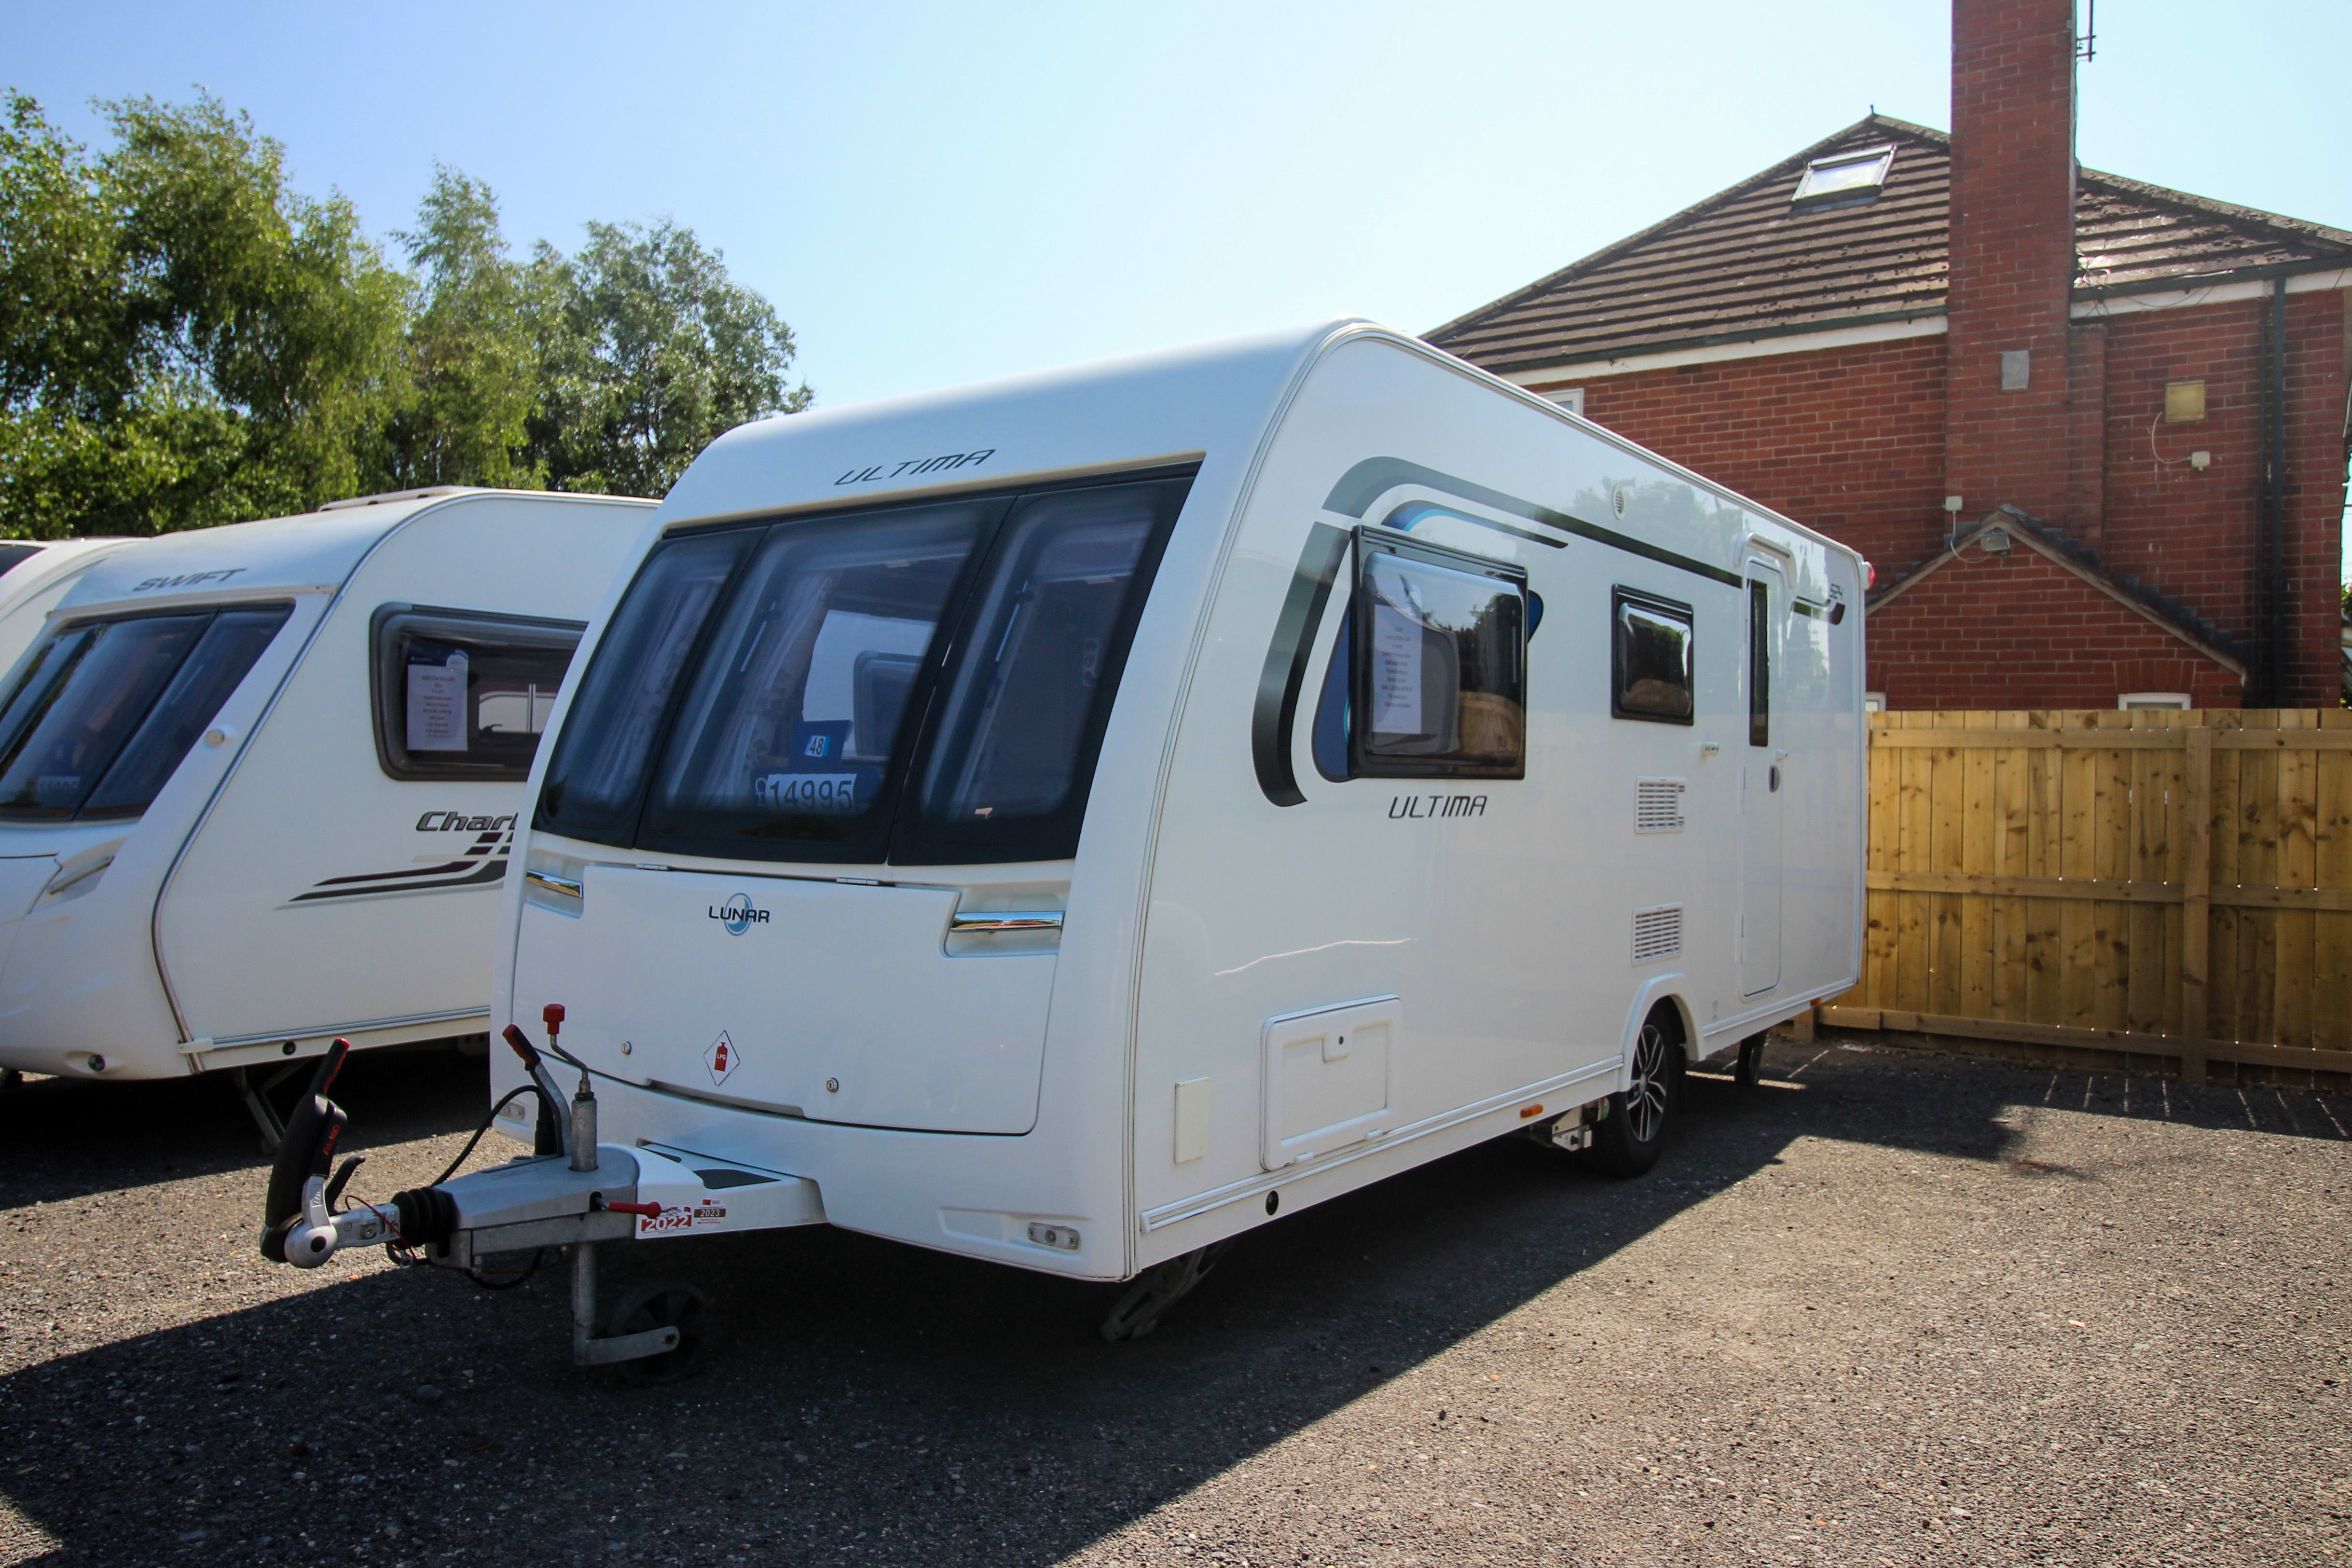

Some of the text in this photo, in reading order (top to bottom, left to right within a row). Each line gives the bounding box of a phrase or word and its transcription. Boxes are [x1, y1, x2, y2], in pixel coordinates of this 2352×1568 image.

[834, 449, 996, 485] ULTIMA
[132, 567, 248, 592] SWIFT
[809, 737, 824, 756] 48
[755, 778, 853, 810] £14995
[1388, 795, 1487, 819] ULTIMA
[708, 906, 770, 923] LUNAR
[645, 1215, 688, 1231] 2022
[700, 1209, 720, 1217] 2023
